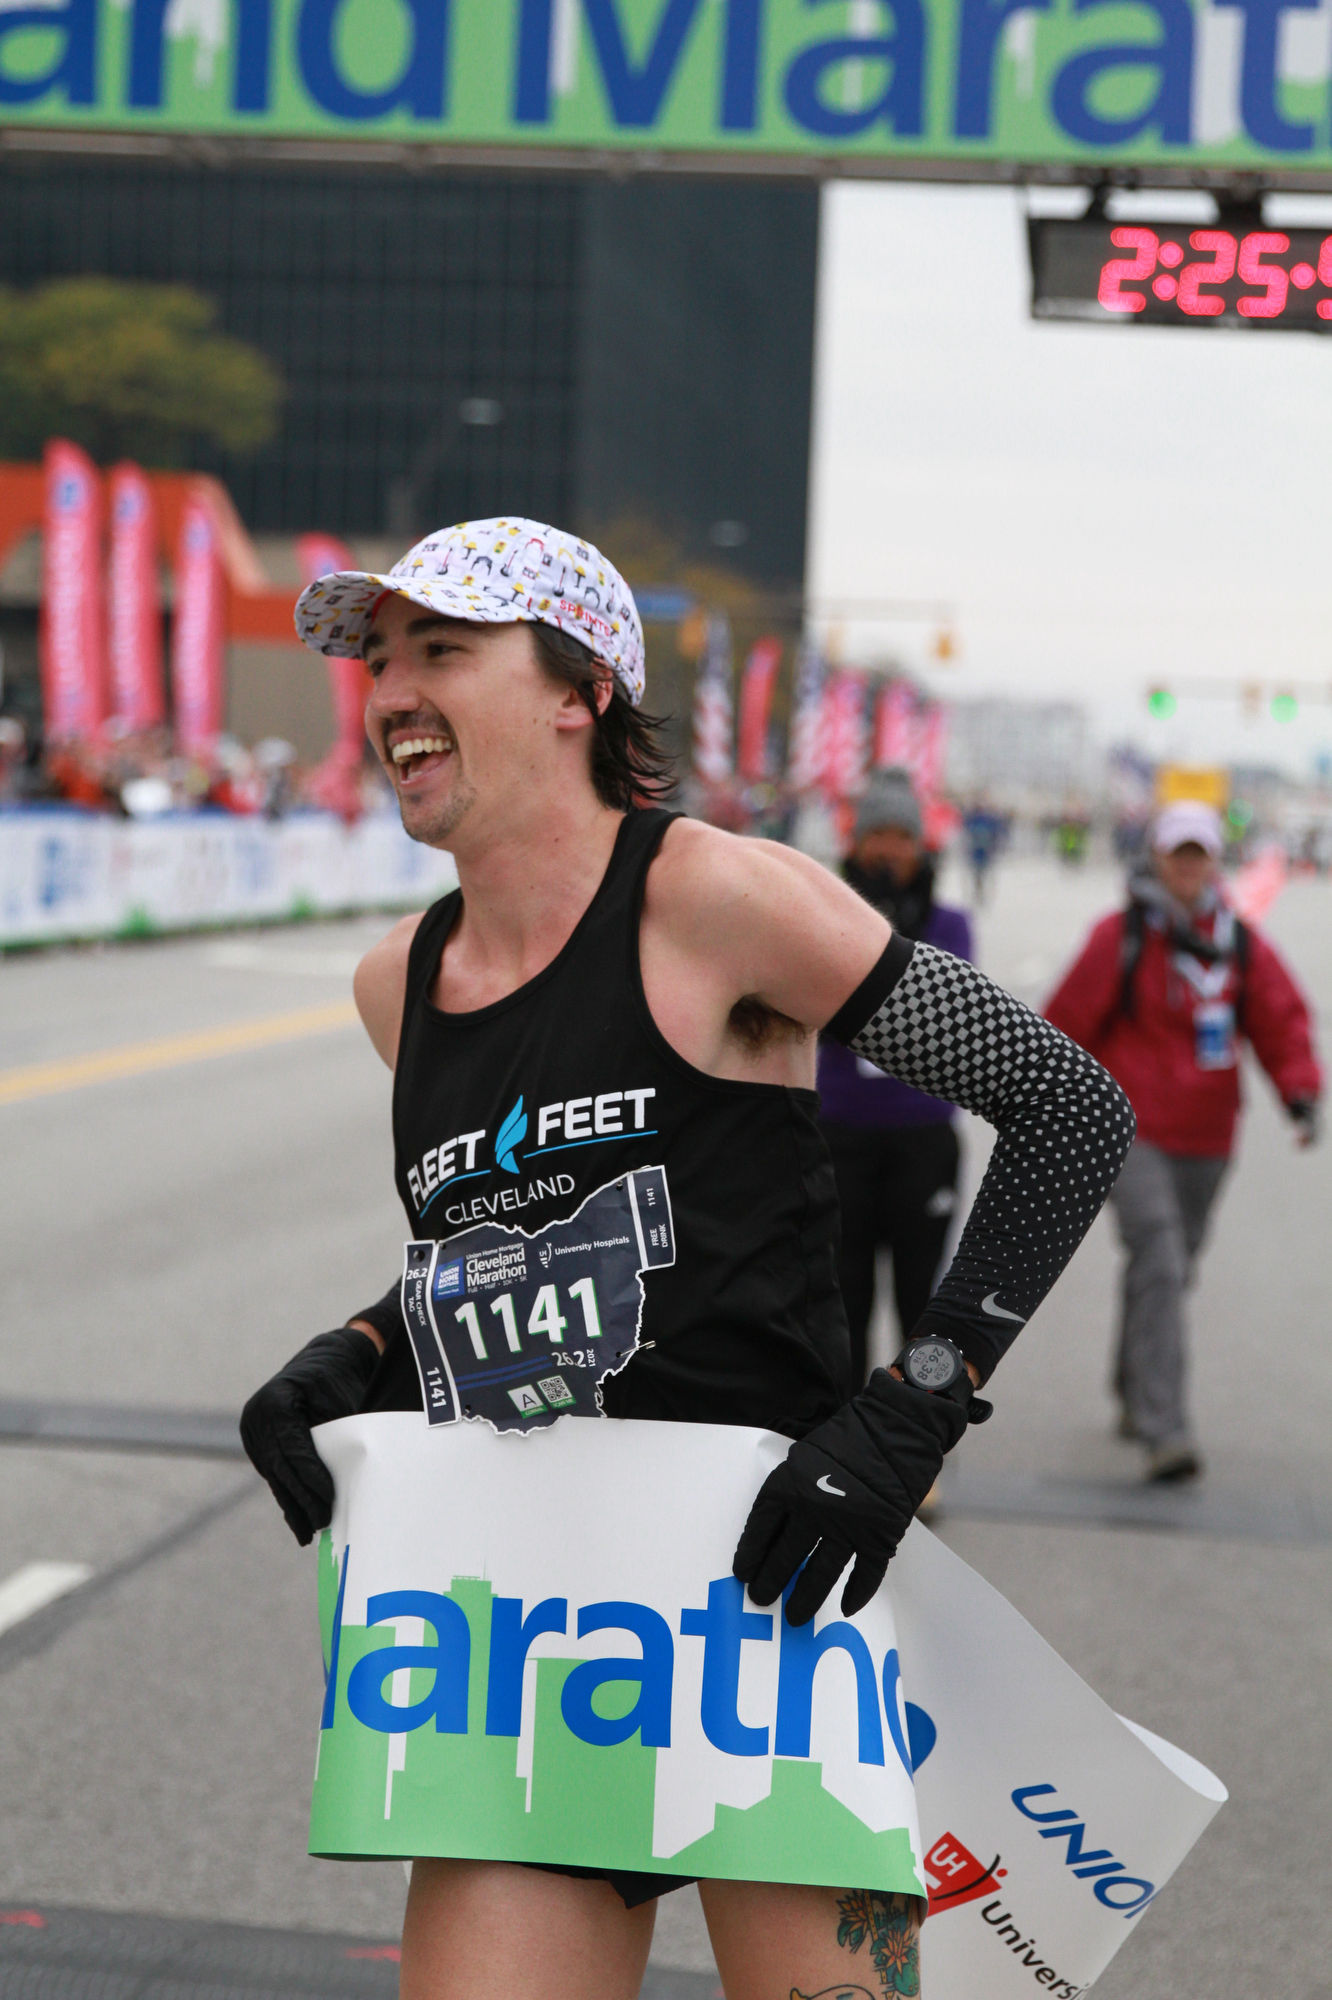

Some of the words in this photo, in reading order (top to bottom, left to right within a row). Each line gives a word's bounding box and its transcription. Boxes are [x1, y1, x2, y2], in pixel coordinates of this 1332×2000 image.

[512, 0, 1332, 154] Marat
[560, 599, 610, 637] SPRINTS
[406, 1129, 487, 1211] FLEET
[537, 1087, 656, 1146] FEET
[445, 1173, 575, 1225] CLEVELAND
[646, 1188, 656, 1207] 1141
[554, 1242, 592, 1256] University
[593, 1236, 630, 1249] Hospitals
[650, 1228, 659, 1247] FREE
[658, 1223, 668, 1248] DRINK
[466, 1252, 482, 1260] Union
[482, 1247, 498, 1256] Home
[498, 1242, 524, 1253] Mortgage
[466, 1247, 526, 1274] Cleveland
[406, 1267, 428, 1280] 26.2
[438, 1272, 459, 1285] HOME
[440, 1265, 459, 1278] UNION
[466, 1264, 527, 1287] Marathon
[415, 1280, 423, 1301] GEAR
[408, 1296, 416, 1312] TAG
[416, 1302, 427, 1326] CHECK
[454, 1277, 602, 1360] 1141
[551, 1350, 587, 1368] 26.2
[586, 1348, 596, 1367] 2021
[917, 1347, 944, 1380] 26.38
[427, 1367, 447, 1408] 1141
[522, 1393, 537, 1408] A
[930, 1843, 968, 1876] UH
[1011, 1783, 1164, 1919] UNIO
